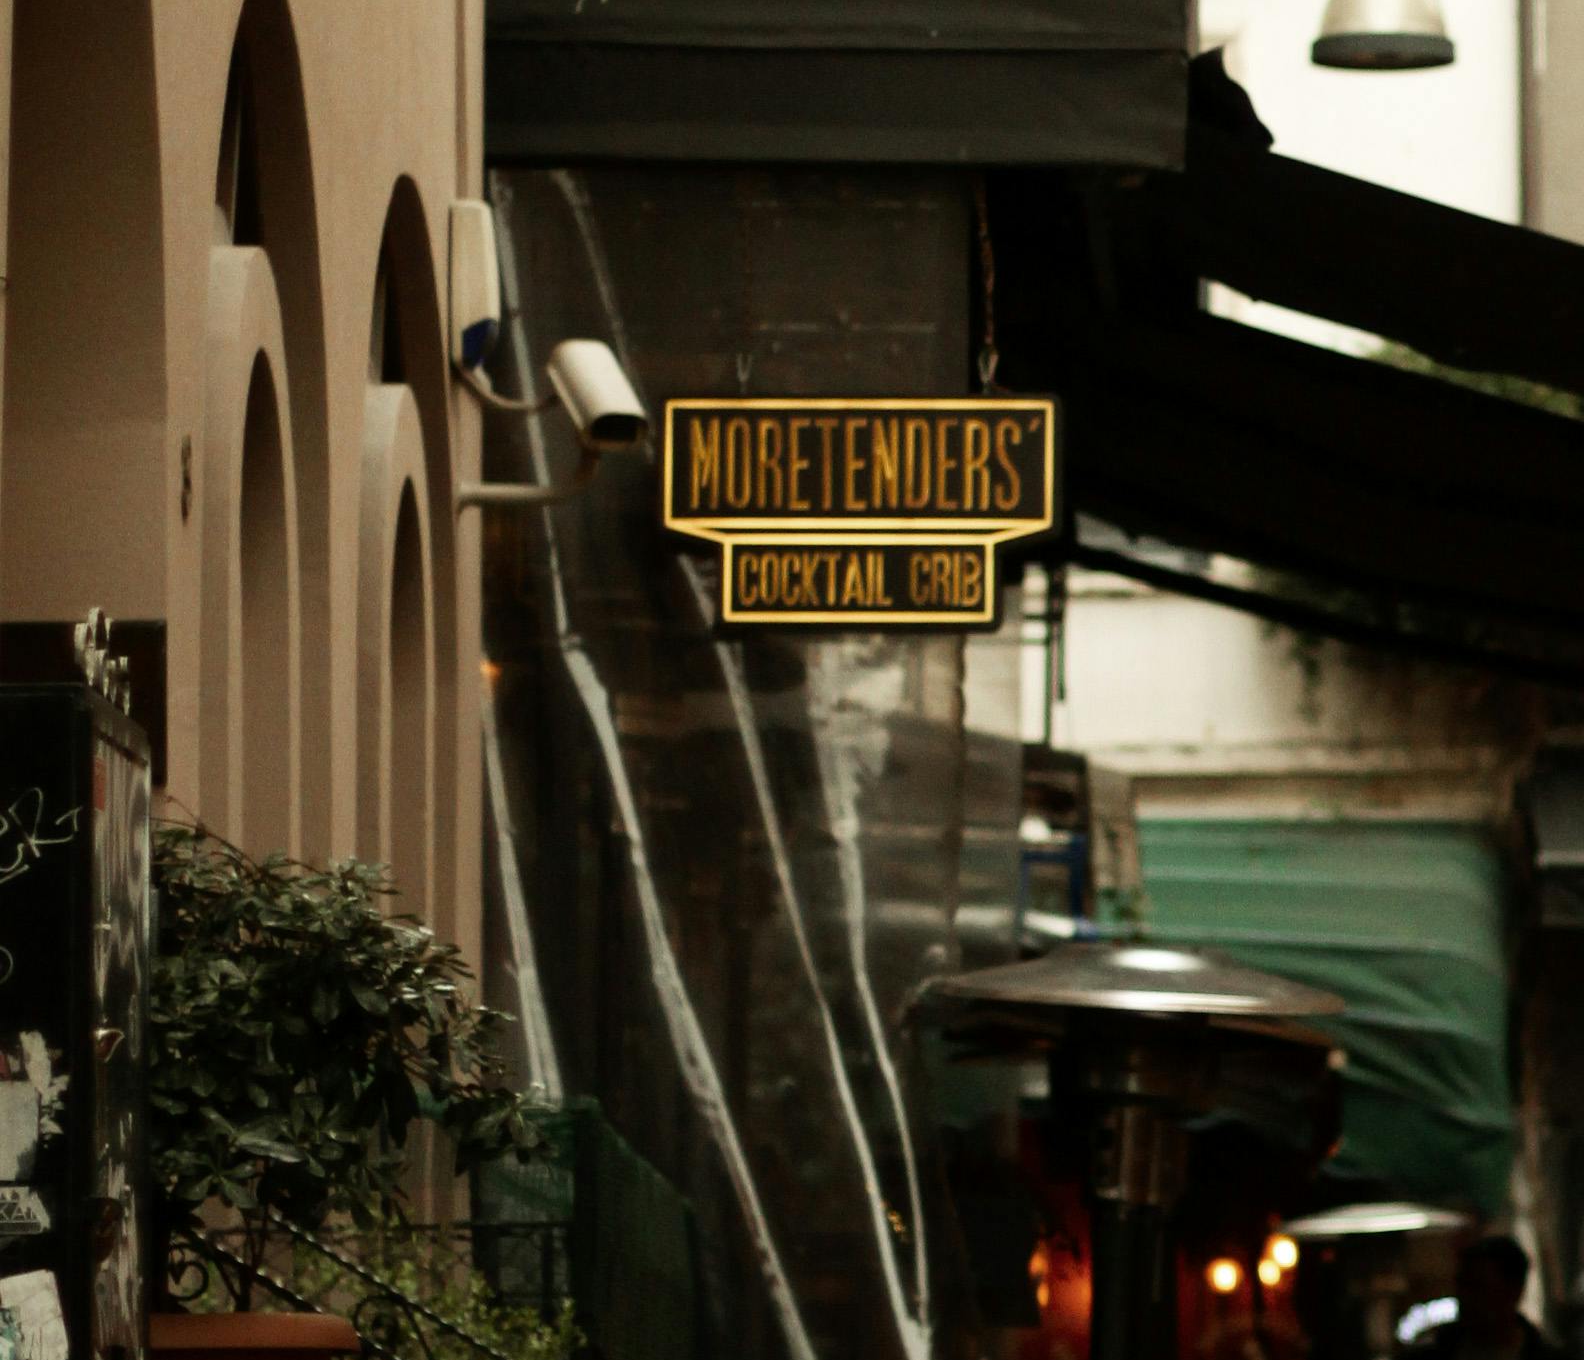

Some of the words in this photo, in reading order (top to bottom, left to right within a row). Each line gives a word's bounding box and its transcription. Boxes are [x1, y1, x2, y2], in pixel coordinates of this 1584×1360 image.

[689, 416, 1041, 510] MORETENDERS'
[738, 552, 892, 607] COCKTAIL
[910, 553, 981, 607] CRIB
